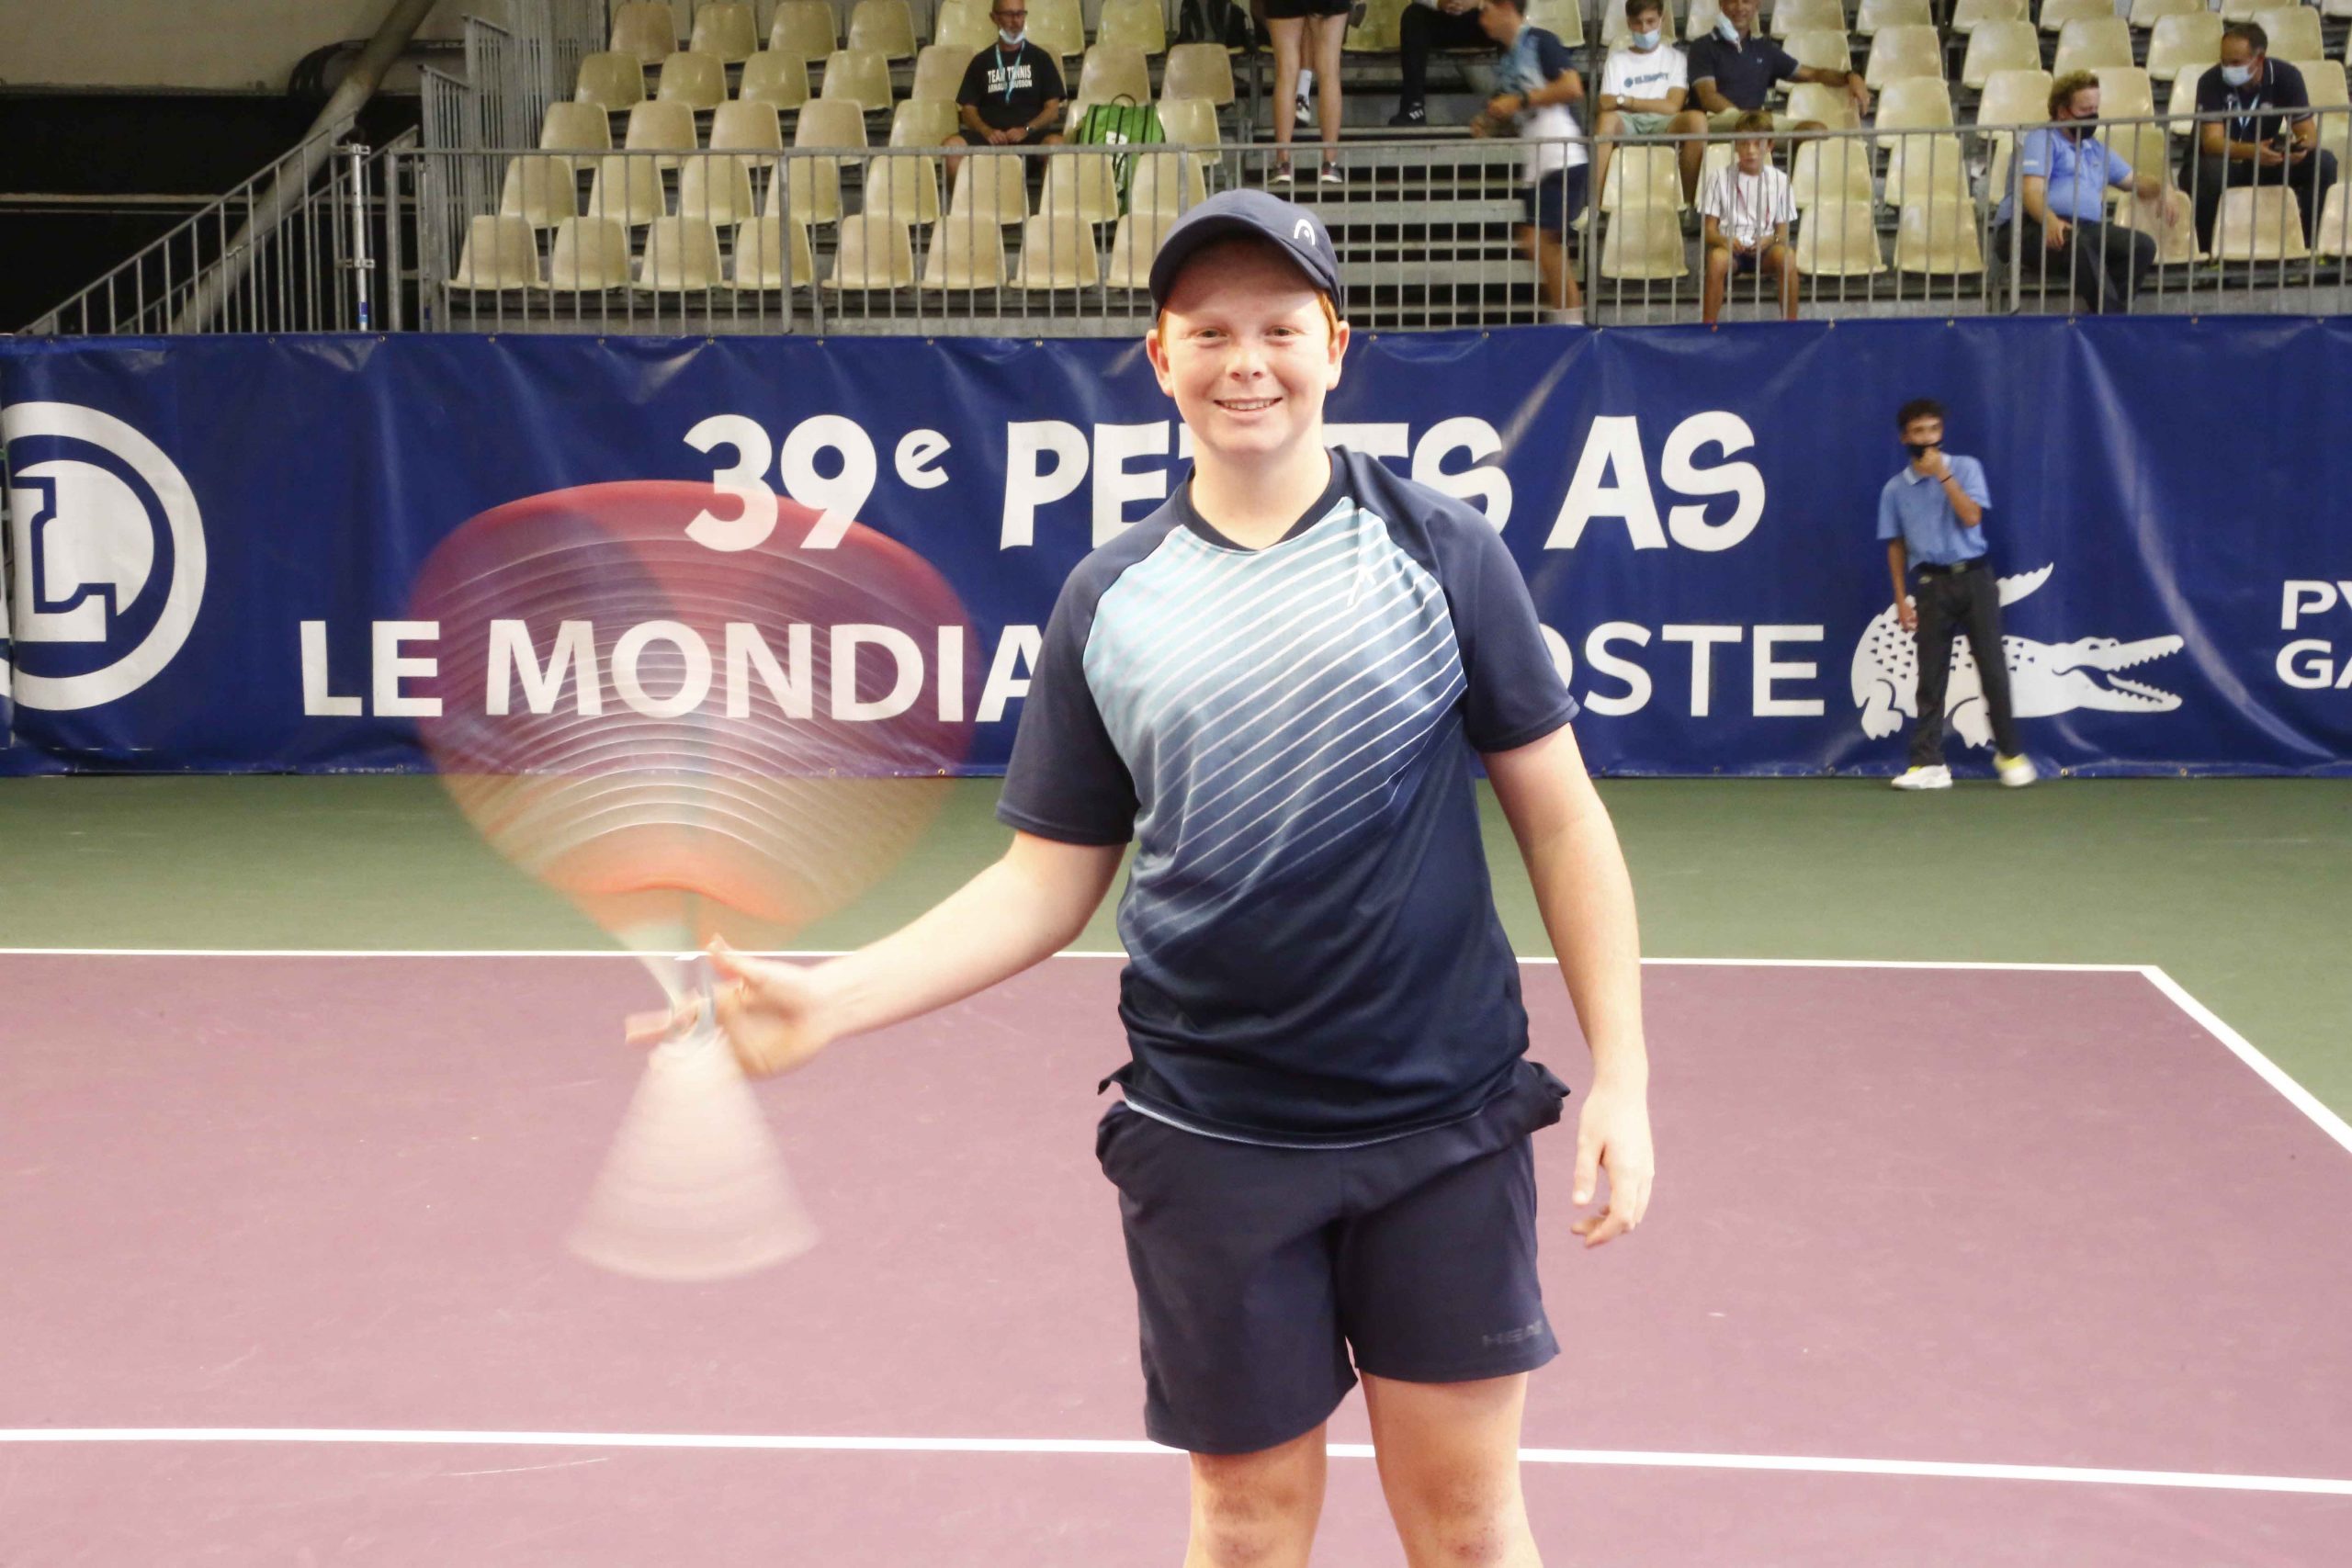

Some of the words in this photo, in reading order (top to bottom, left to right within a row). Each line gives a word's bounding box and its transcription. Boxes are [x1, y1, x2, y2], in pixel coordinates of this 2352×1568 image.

[683, 413, 952, 552] 39e
[1000, 415, 1513, 551] PES
[1544, 411, 1766, 552] AS
[300, 619, 443, 717] LE
[485, 618, 1043, 724] MONDIA
[1539, 621, 1826, 717] STE
